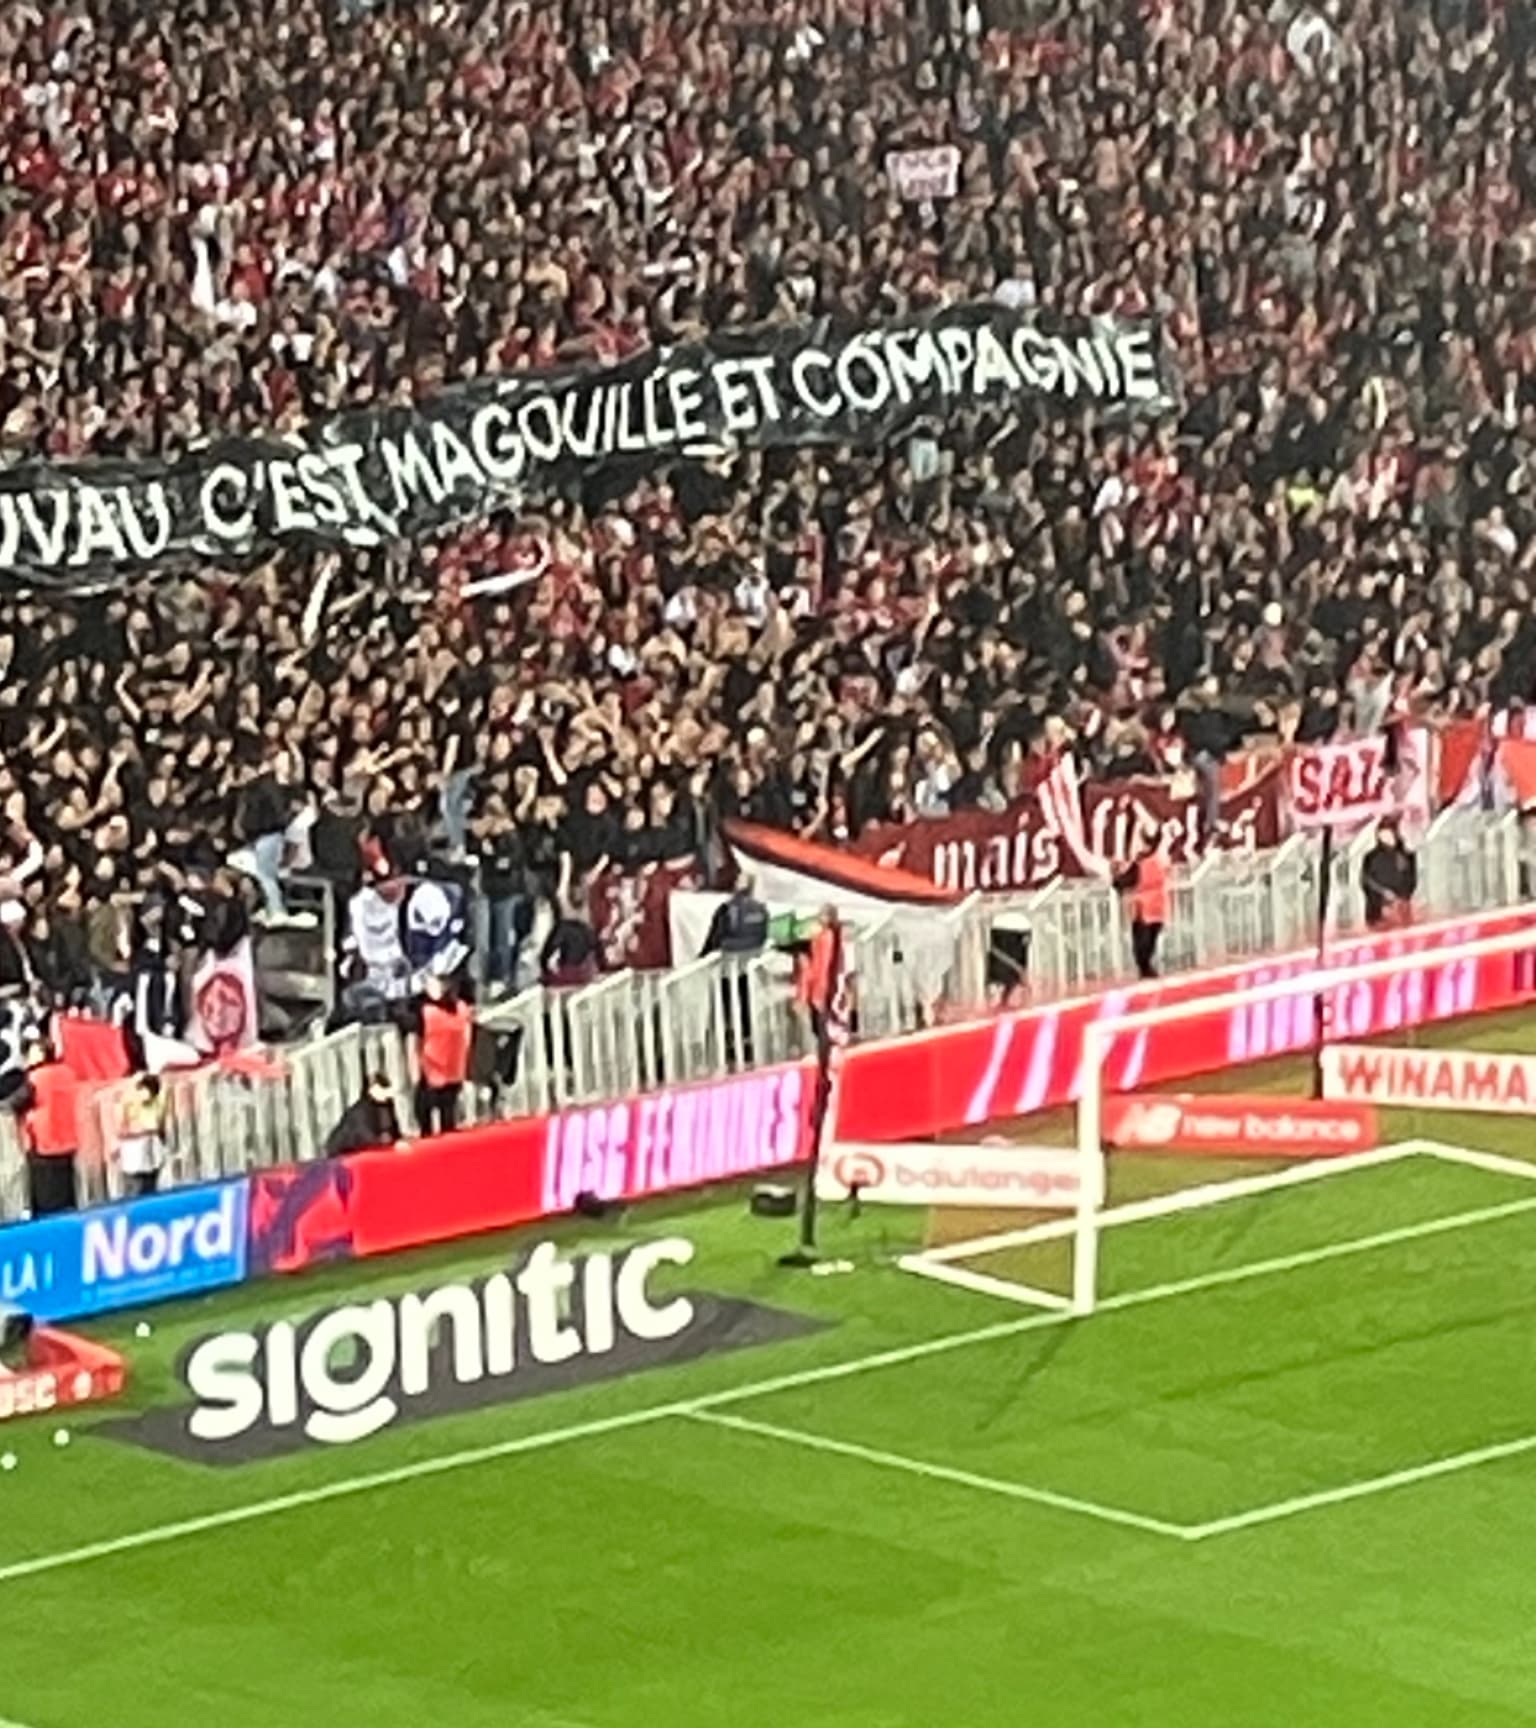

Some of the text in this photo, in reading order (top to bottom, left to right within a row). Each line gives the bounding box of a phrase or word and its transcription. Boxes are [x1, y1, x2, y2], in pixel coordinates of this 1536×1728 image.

[200, 444, 394, 540] C'EST
[381, 368, 707, 512] MAGOUILLE
[711, 355, 780, 430] ET
[792, 327, 1160, 416] COMPAGNIE
[933, 812, 1061, 890] mais
[1182, 1114, 1242, 1137] new
[1244, 1111, 1361, 1142] balance
[895, 1164, 1082, 1196] boulange
[81, 1187, 236, 1285] Nord
[187, 1238, 694, 1444] signitic
